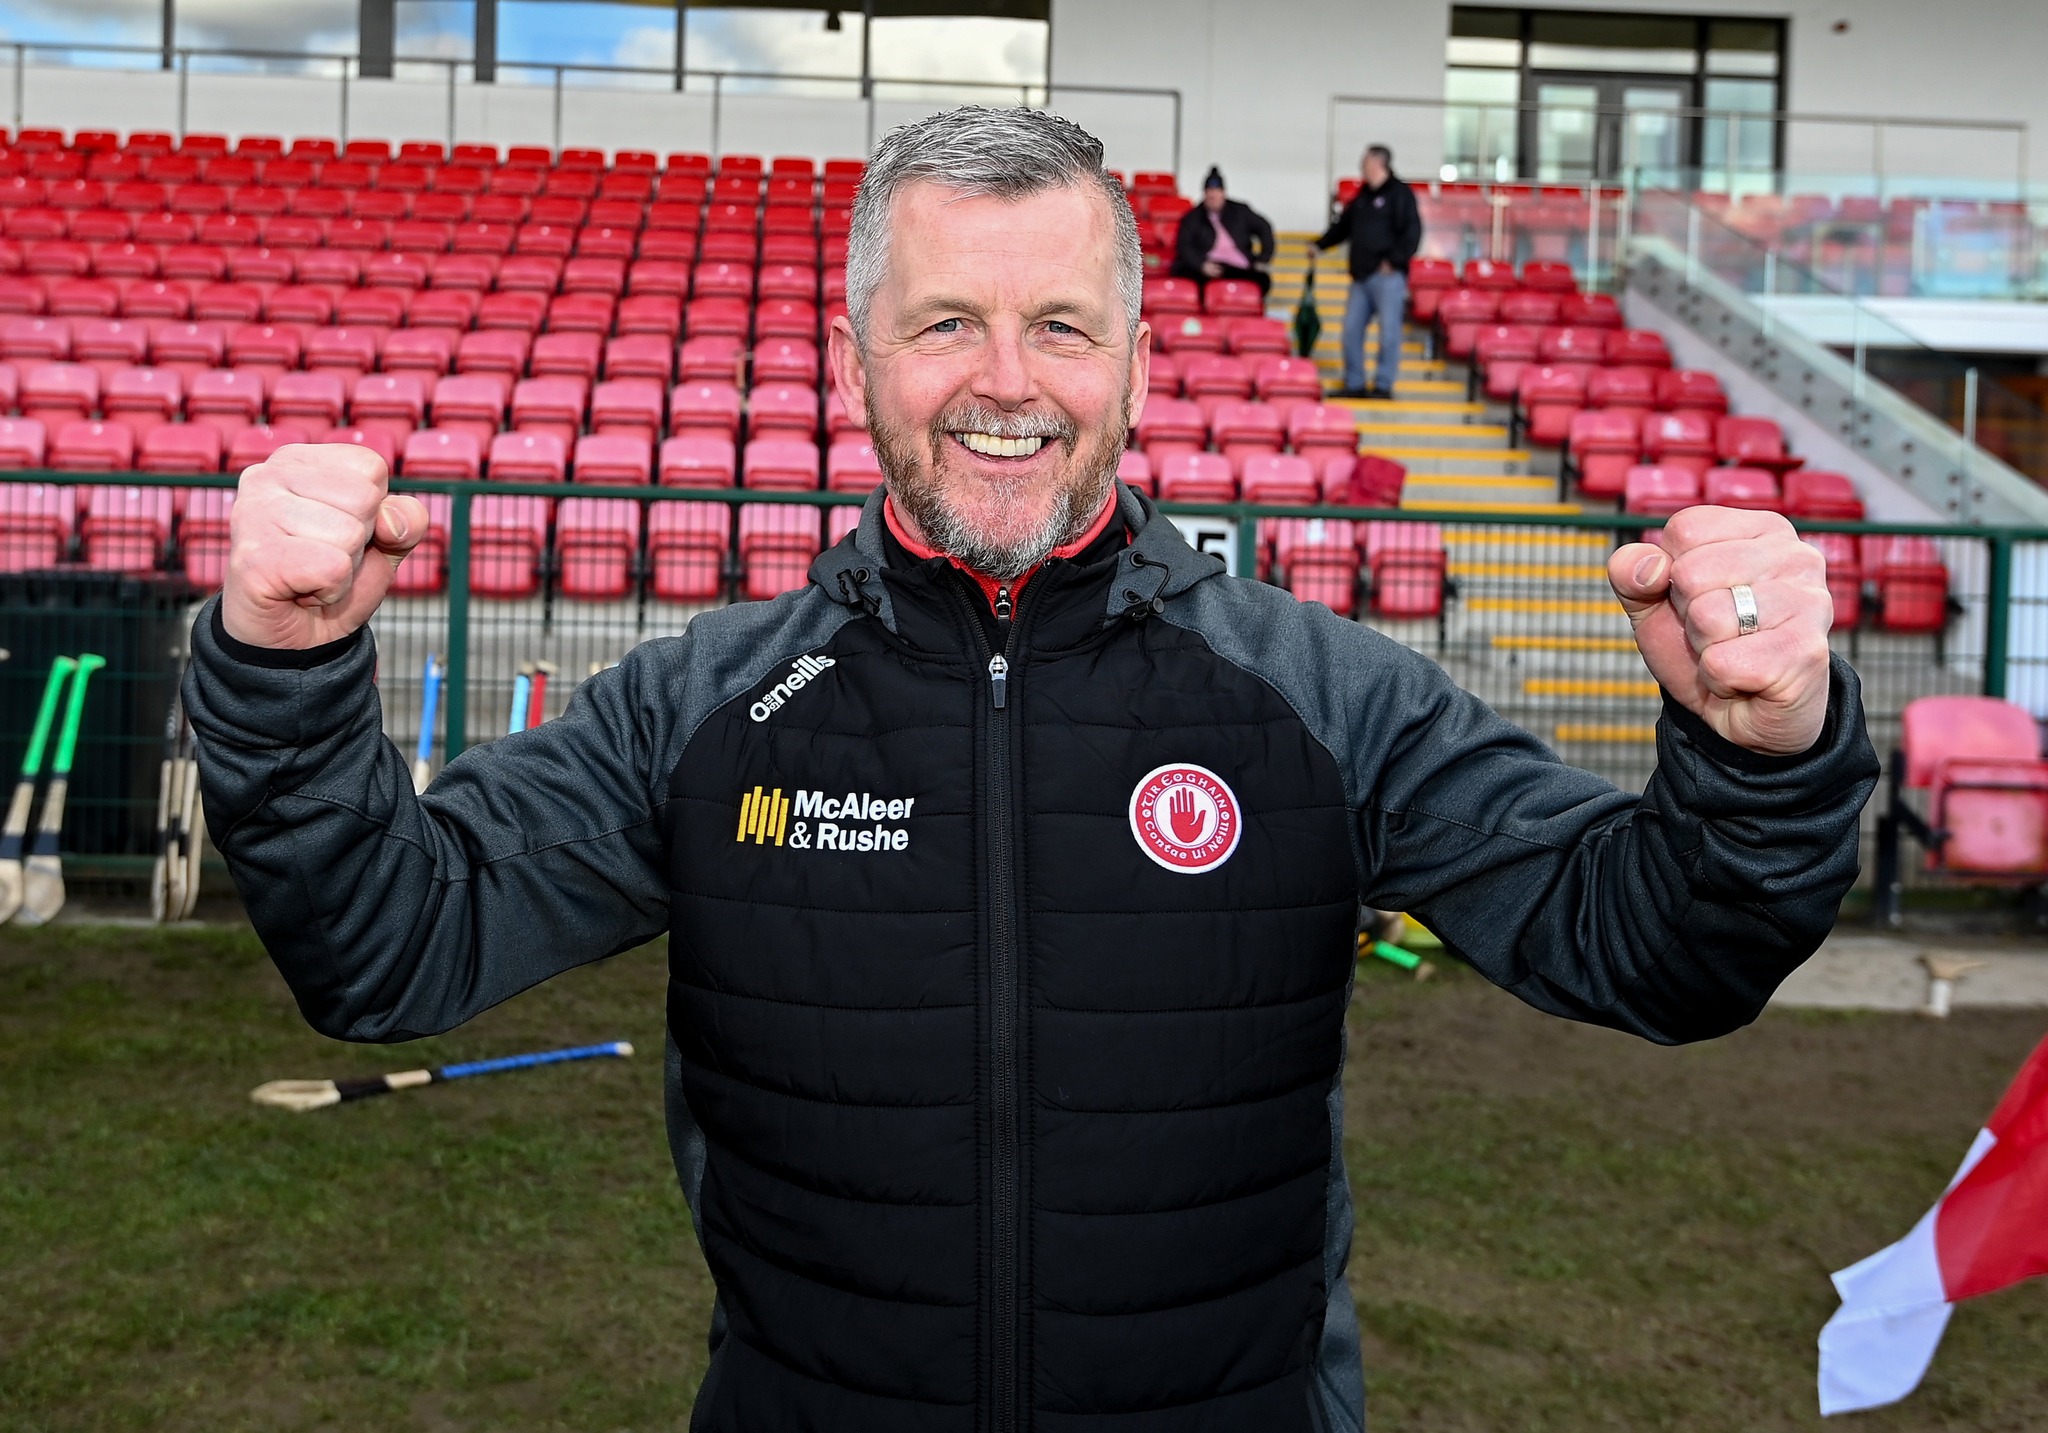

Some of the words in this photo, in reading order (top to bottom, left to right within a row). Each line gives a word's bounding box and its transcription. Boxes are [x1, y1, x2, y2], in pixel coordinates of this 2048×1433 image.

[793, 790, 914, 820] McAleer
[1161, 773, 1228, 809] EOGHAIN
[789, 821, 811, 849] &
[817, 823, 909, 851] Rushe
[1145, 821, 1187, 859] Contae
